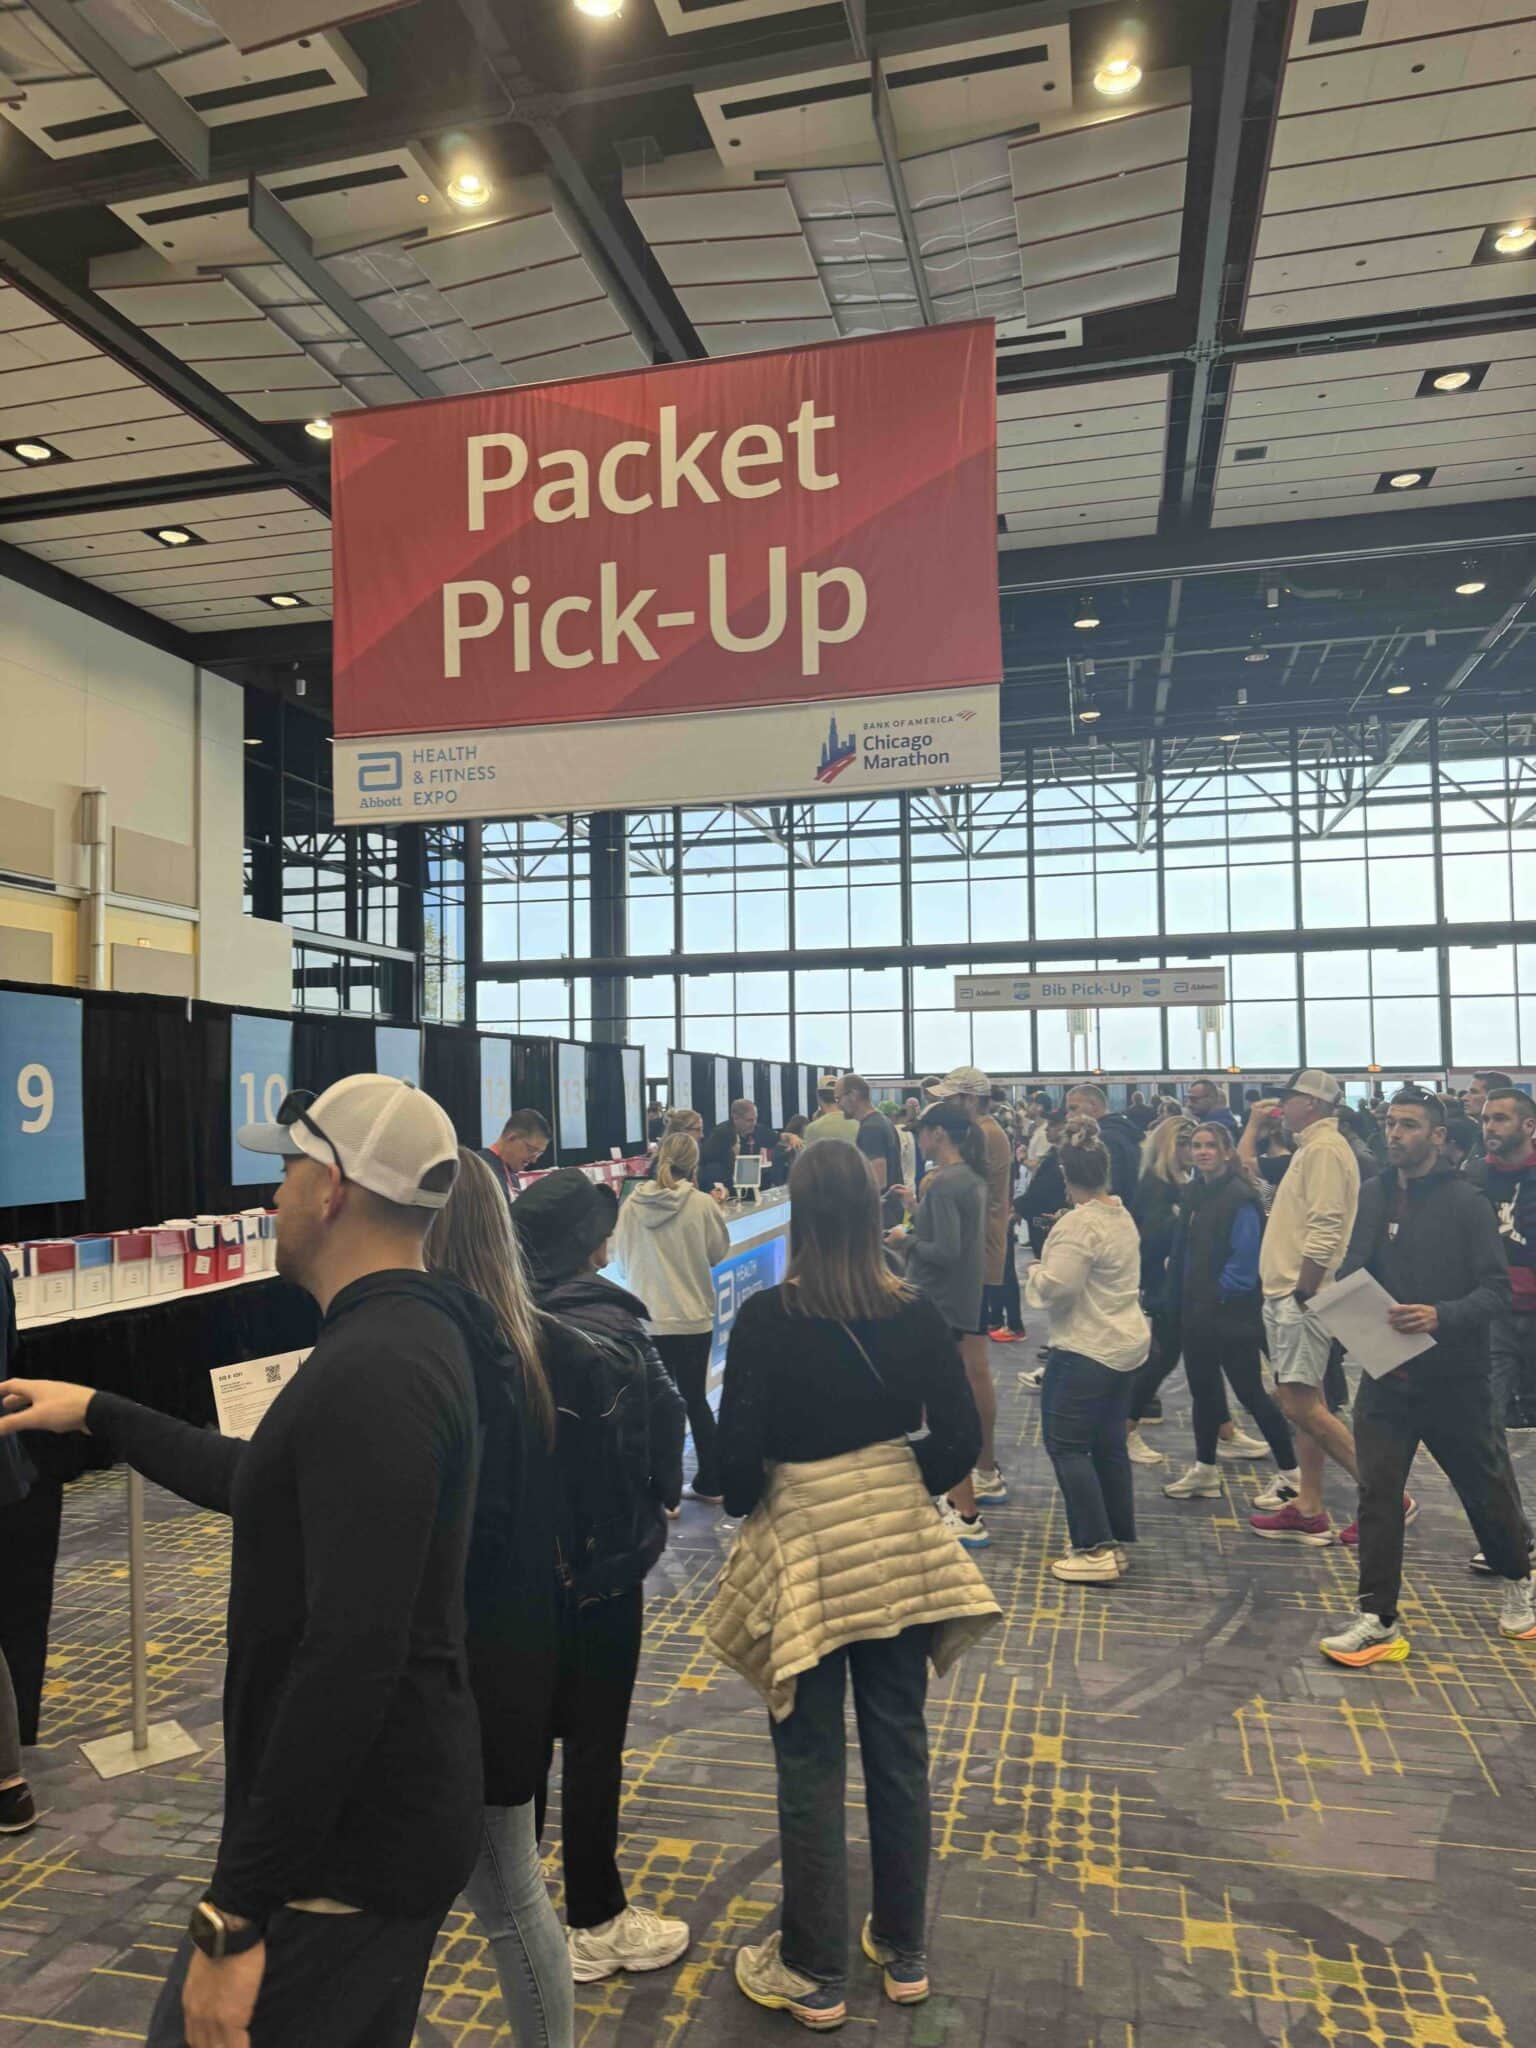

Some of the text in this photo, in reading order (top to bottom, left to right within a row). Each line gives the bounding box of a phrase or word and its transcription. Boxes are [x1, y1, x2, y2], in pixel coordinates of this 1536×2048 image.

[467, 400, 840, 532] Packet
[443, 546, 868, 678] Pick-Up
[863, 715, 954, 730] BANK OF AMERICA
[863, 733, 933, 751] Chicago
[412, 745, 478, 764] HEALTH
[863, 751, 950, 770] Marathon
[413, 765, 497, 785] & FITNESS
[359, 796, 402, 809] Abbott
[413, 789, 458, 806] EXPO
[1042, 983, 1067, 997] Bib
[1072, 981, 1132, 997] Pick-Up
[17, 1063, 54, 1133] 9
[239, 1072, 288, 1124] 10
